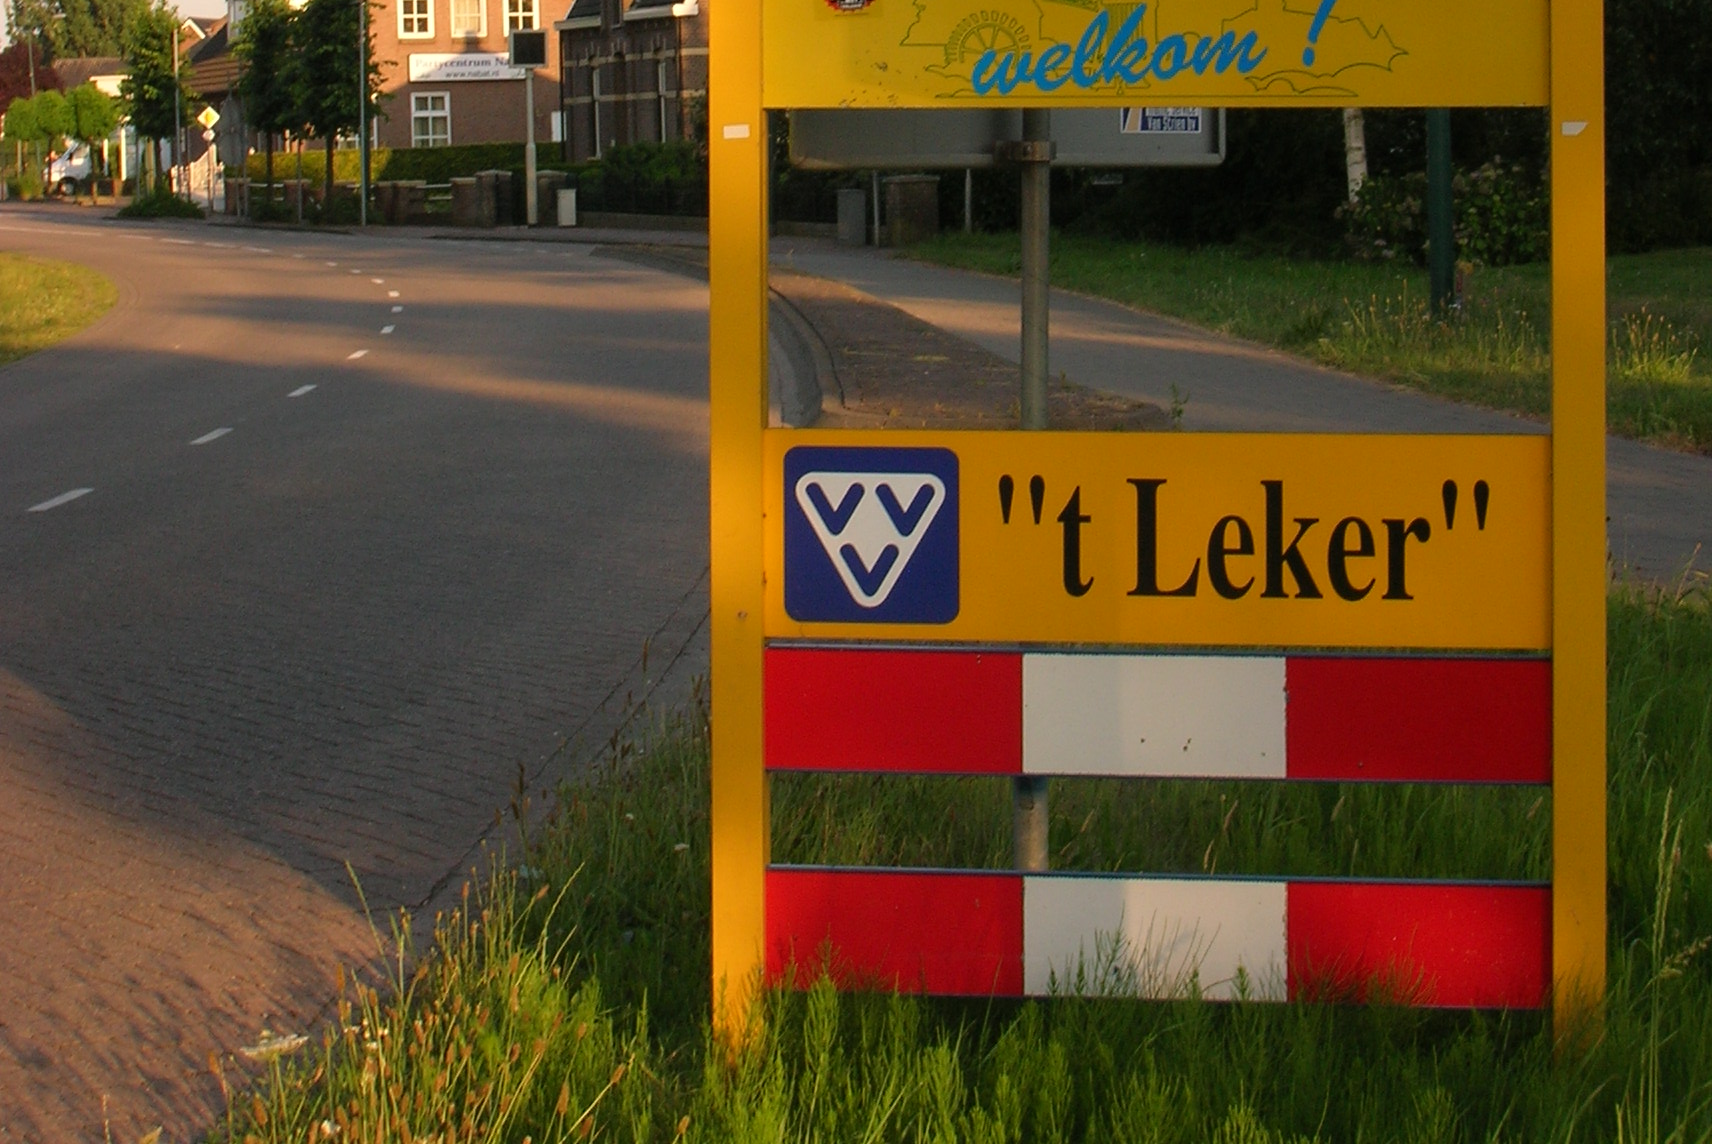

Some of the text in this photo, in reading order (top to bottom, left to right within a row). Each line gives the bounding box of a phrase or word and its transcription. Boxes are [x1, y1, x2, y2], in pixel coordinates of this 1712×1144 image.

[415, 57, 510, 70] Partycentrum Na
[972, 2, 1270, 96] welkom
